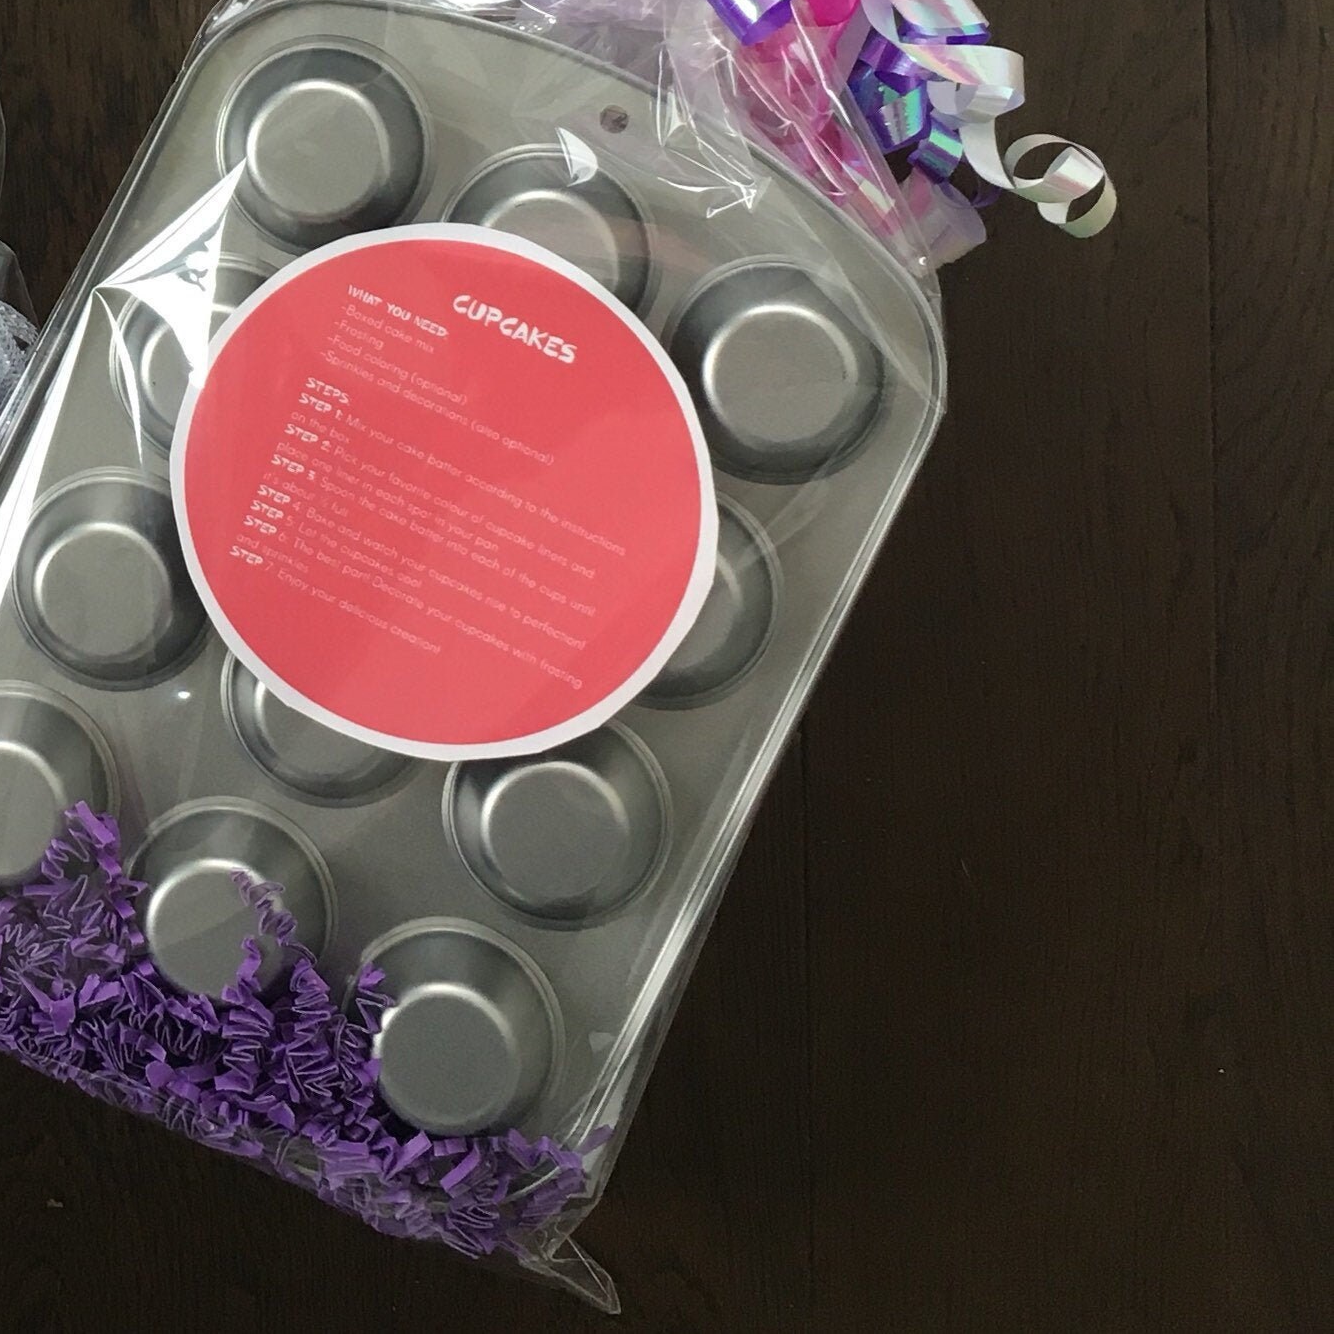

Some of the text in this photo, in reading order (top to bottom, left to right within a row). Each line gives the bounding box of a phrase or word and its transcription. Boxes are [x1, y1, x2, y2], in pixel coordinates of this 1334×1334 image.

[347, 284, 382, 305] WHAT
[386, 302, 411, 320] YOU
[452, 294, 577, 363] CUPCAKES
[298, 392, 332, 412] STEP
[284, 423, 318, 442] STEP
[270, 453, 304, 473] STEP
[256, 484, 291, 503] STEP
[250, 499, 283, 519] STEP
[243, 514, 277, 534] STEP
[229, 545, 263, 565] STEP
